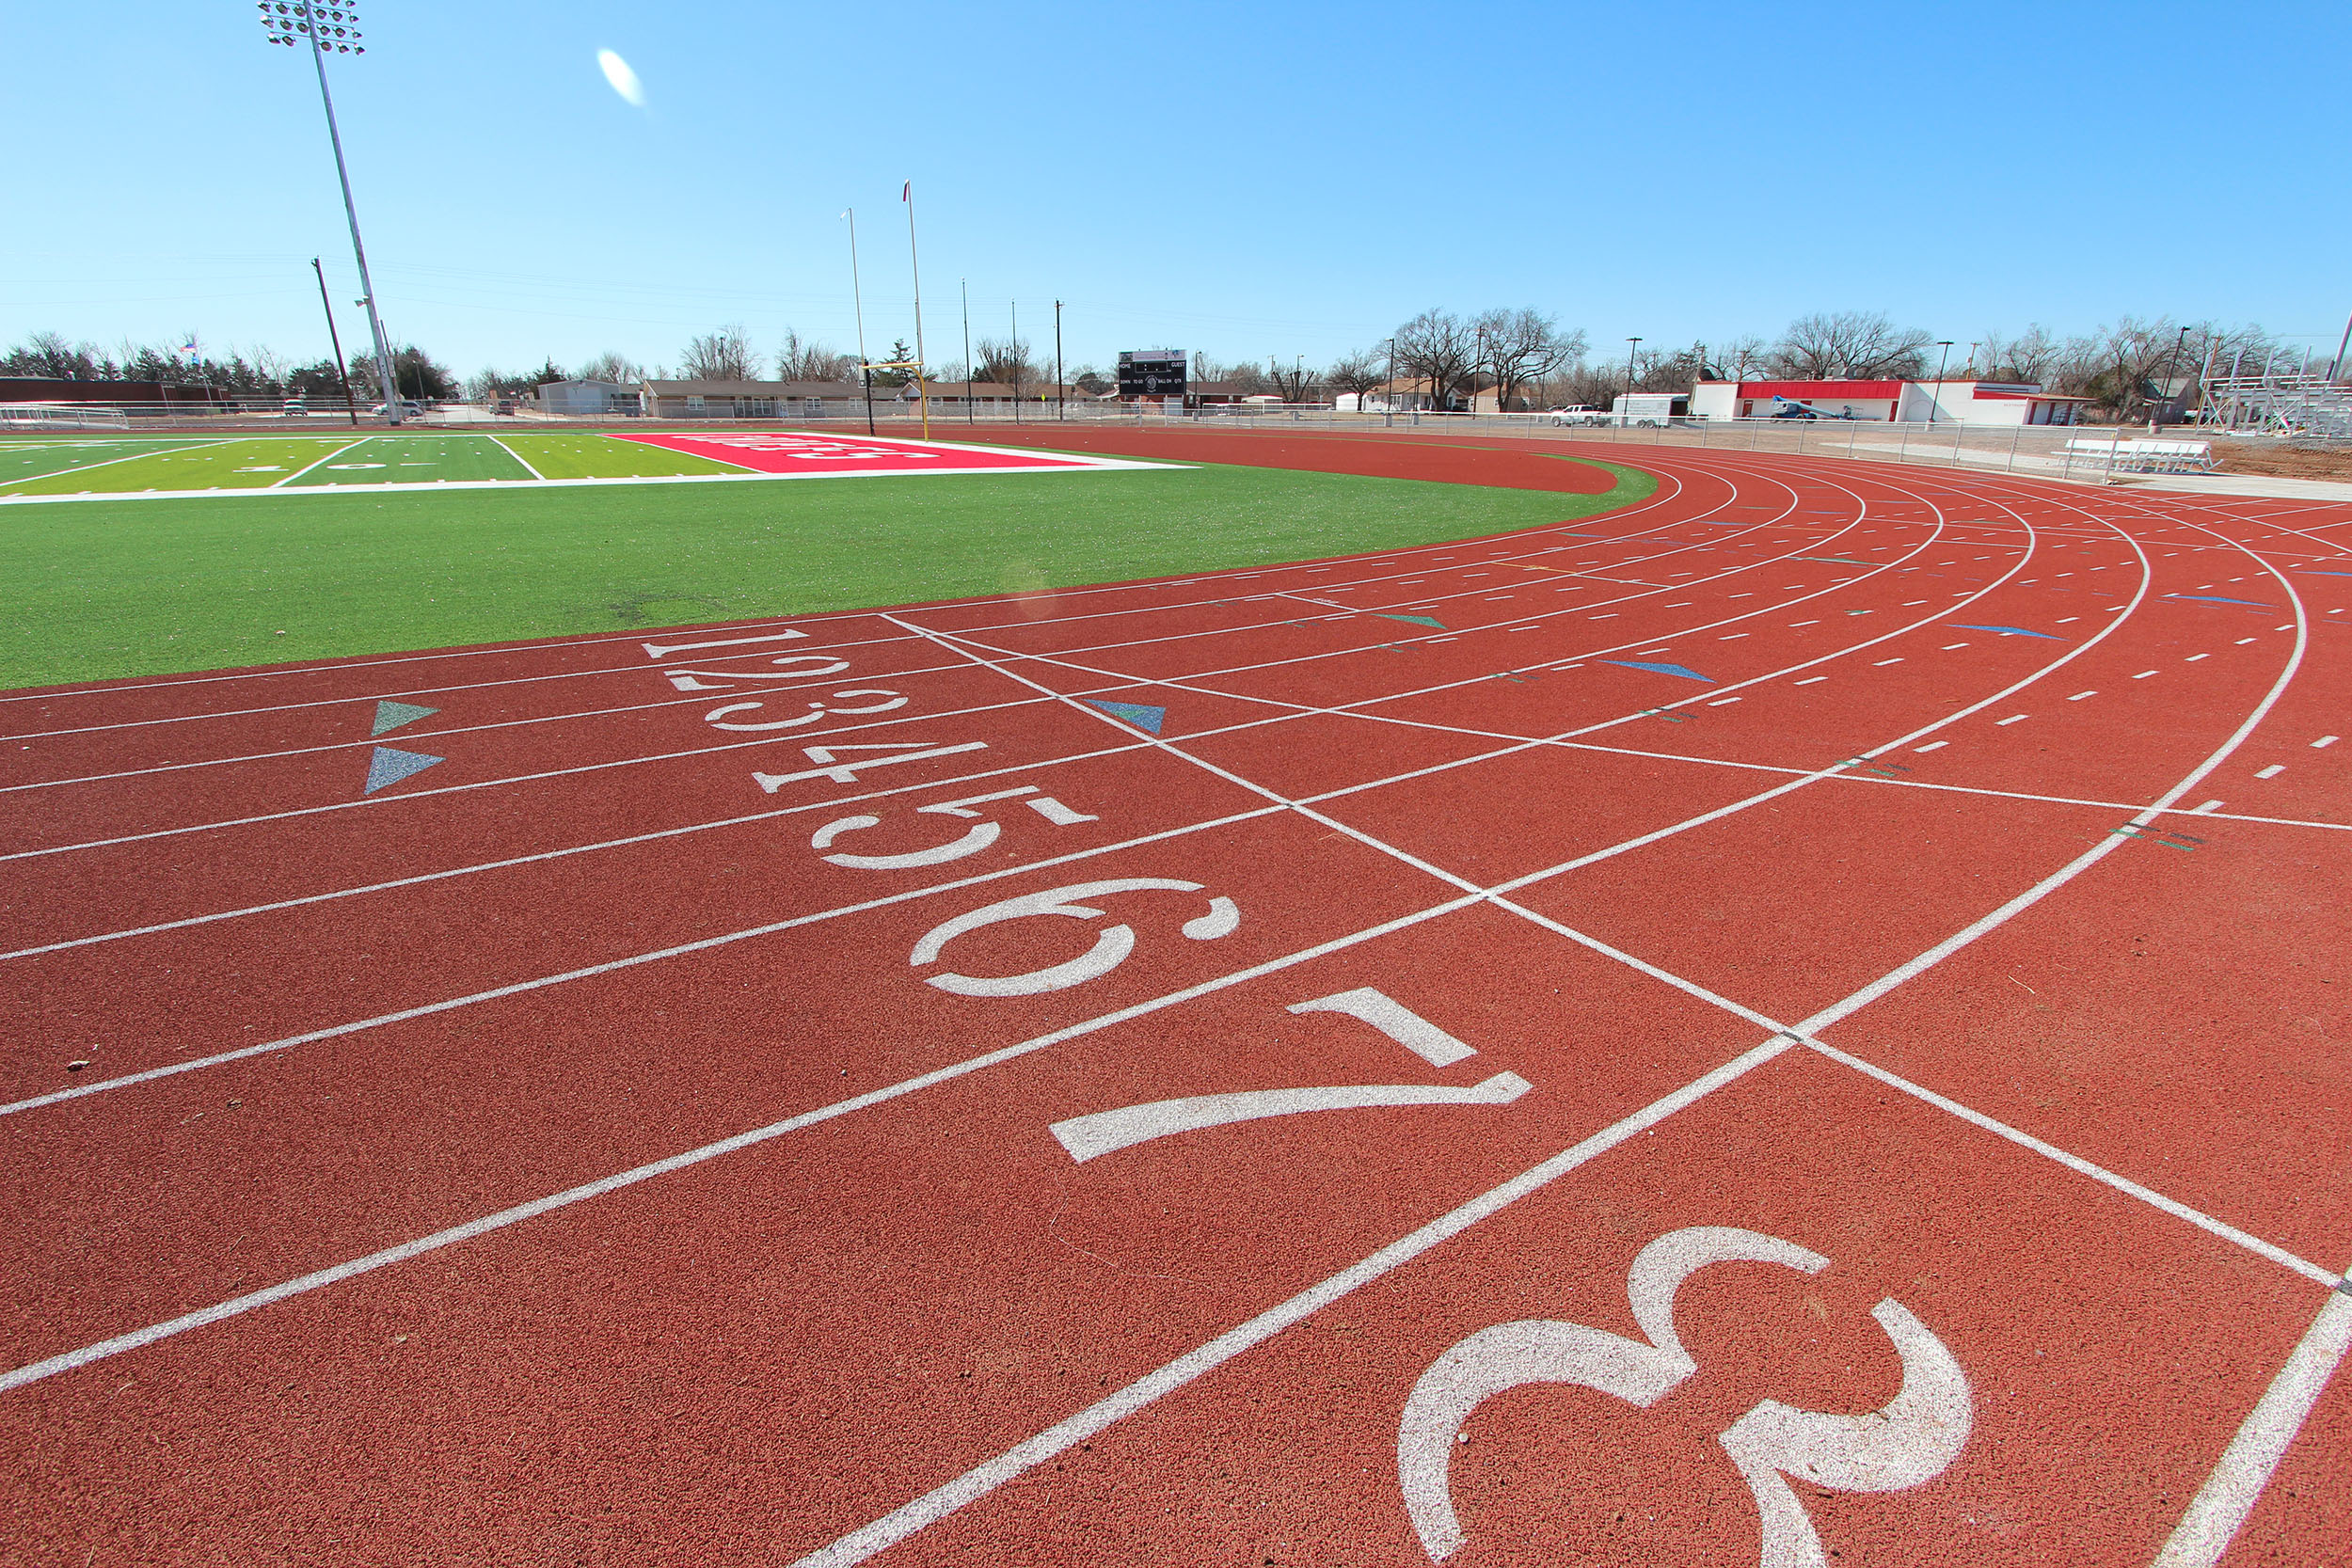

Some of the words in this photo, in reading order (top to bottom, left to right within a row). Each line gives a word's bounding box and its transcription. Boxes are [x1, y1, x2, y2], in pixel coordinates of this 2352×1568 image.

[642, 628, 810, 659] 1
[663, 656, 850, 692] 2
[705, 689, 909, 732] 3
[752, 741, 989, 794] 4
[811, 784, 1100, 870] 5
[910, 878, 1242, 998] 6
[1048, 986, 1534, 1164] 7
